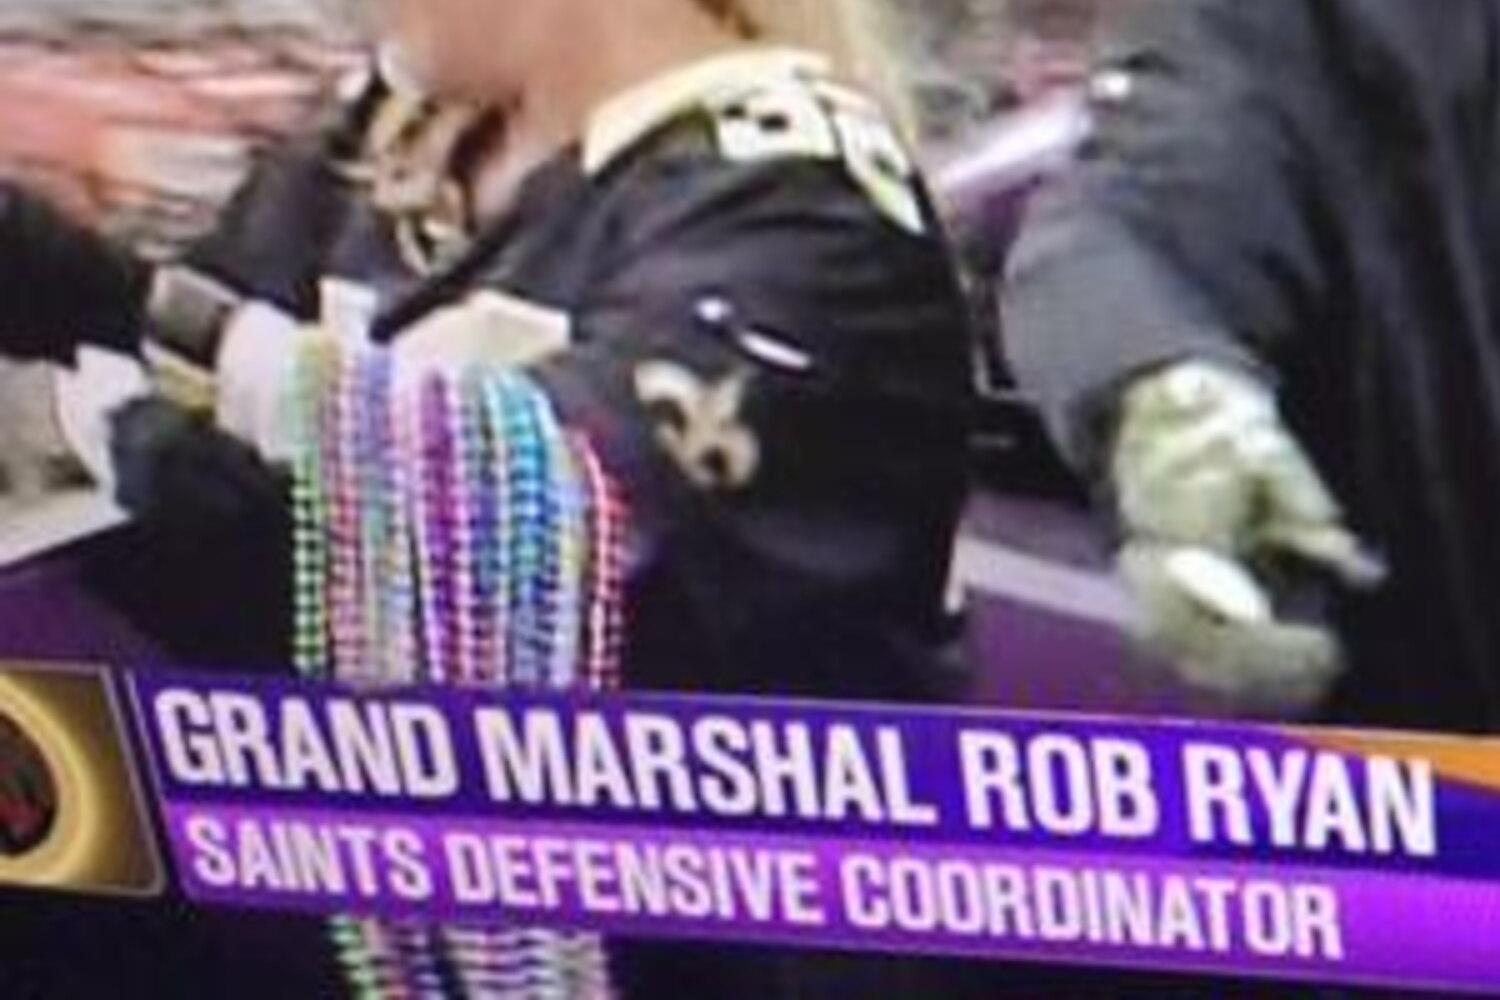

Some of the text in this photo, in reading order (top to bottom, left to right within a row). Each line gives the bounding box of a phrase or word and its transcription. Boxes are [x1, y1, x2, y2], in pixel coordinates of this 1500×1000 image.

[155, 688, 1438, 856] GRAND MARSHAL ROB RYAN
[188, 818, 1344, 960] SAINTS DEFENSIVE COORDINATOR
